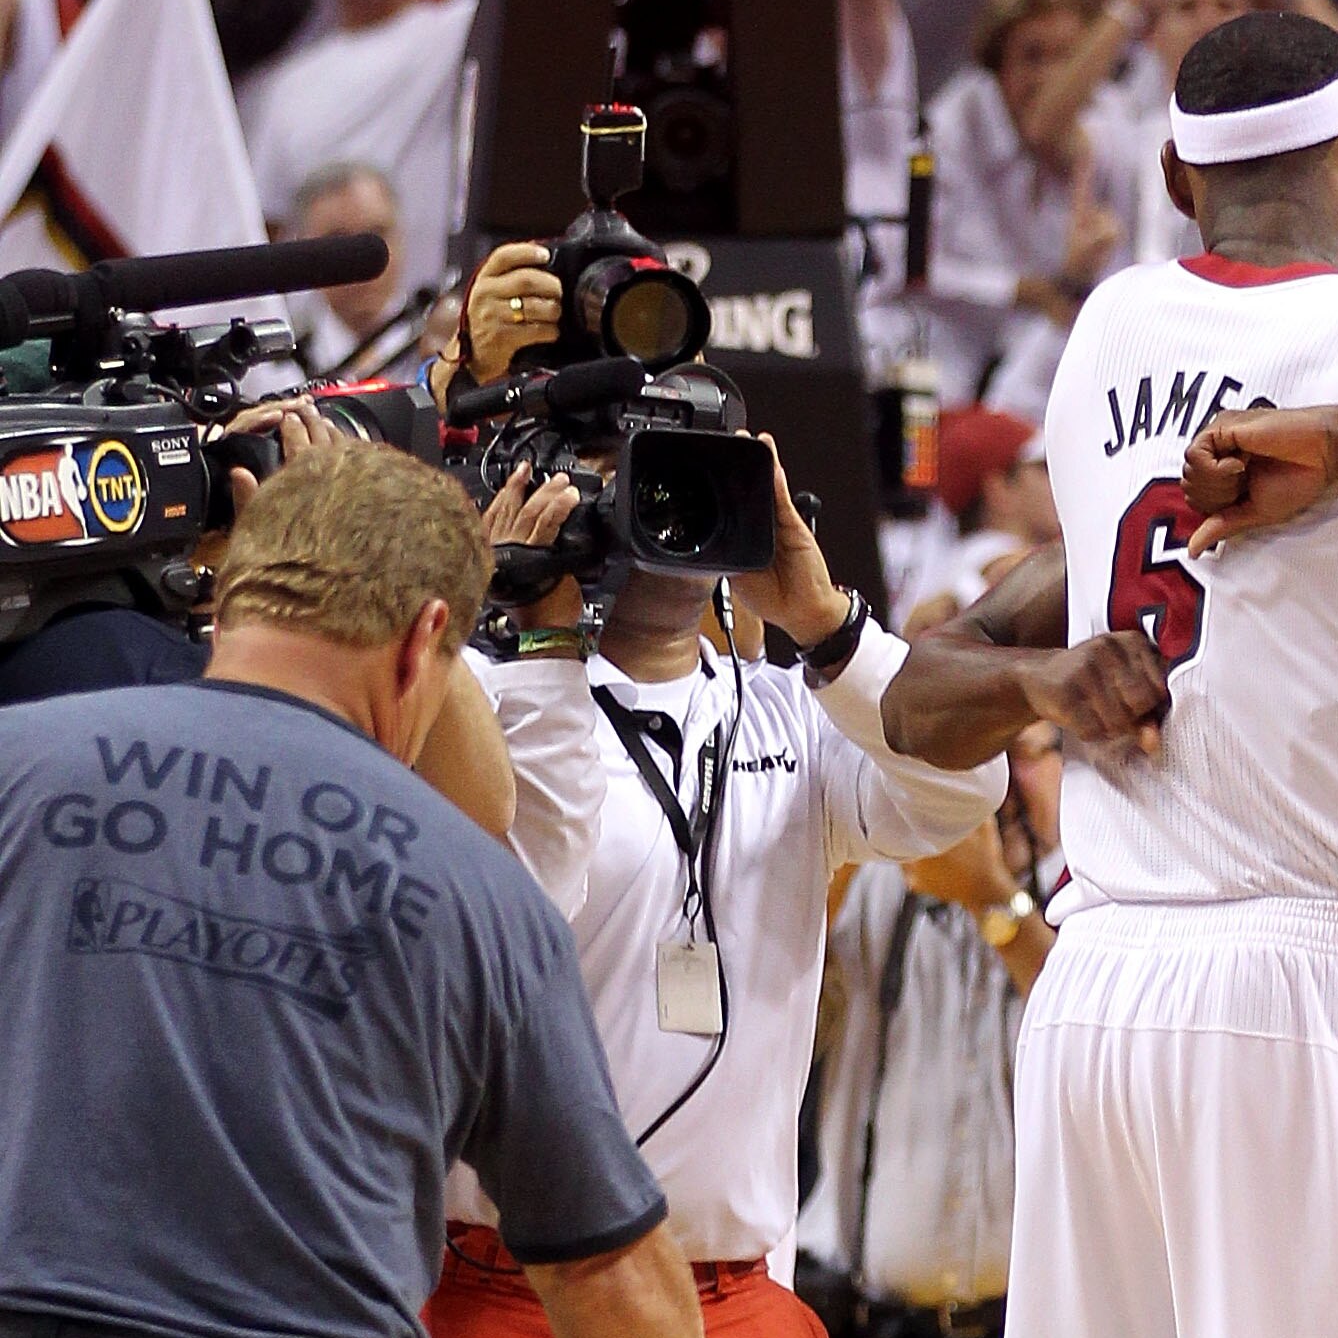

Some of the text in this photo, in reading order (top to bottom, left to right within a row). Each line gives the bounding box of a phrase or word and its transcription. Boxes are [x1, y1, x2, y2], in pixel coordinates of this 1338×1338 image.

[151, 436, 190, 453] SONY
[1104, 371, 1278, 457] JAME
[0, 470, 64, 523] NBA
[97, 474, 134, 503] TNT
[1106, 476, 1222, 676] 6
[96, 735, 421, 859] WIN OR
[42, 793, 440, 941] GO HOME
[106, 899, 360, 999] PLAYOFFS
